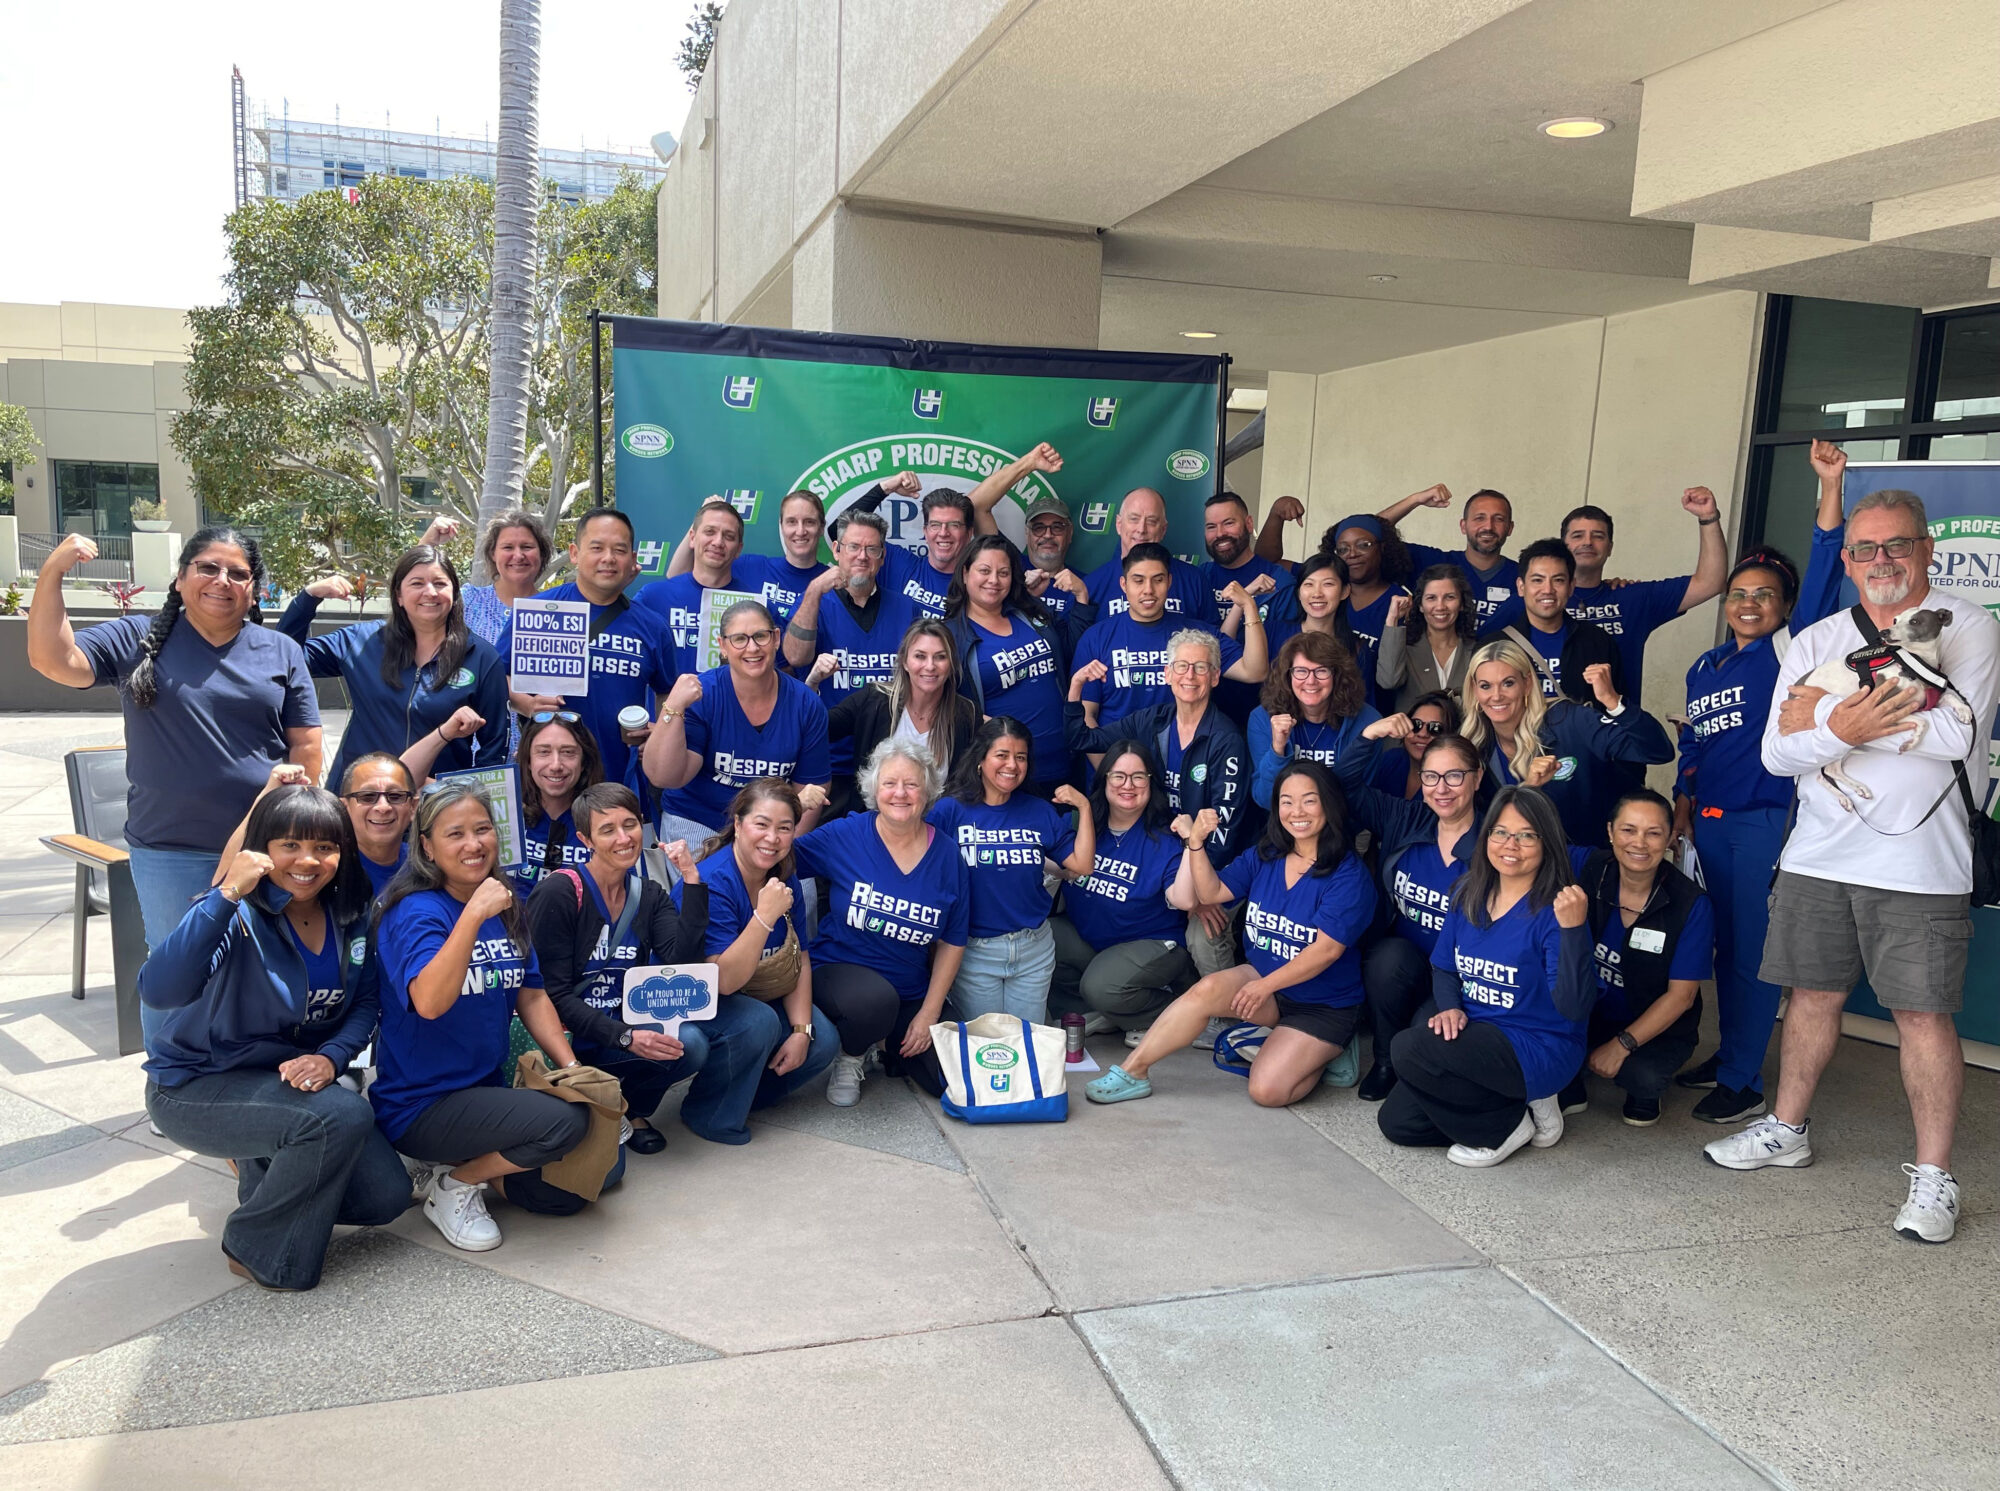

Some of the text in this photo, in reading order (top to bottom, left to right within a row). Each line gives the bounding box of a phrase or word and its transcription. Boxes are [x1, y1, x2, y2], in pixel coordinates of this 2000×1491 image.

[635, 434, 660, 443] SPNN
[1177, 459, 1197, 467] SPNN
[808, 444, 1042, 505] SHARP PROFESSINA
[1951, 519, 2000, 534] PROFE
[1929, 577, 1953, 586] ITED
[1957, 578, 1979, 587] FOR
[903, 579, 947, 609] RESPE
[518, 612, 583, 632] 100% ESI
[1566, 603, 1620, 619] ESPECT
[515, 636, 585, 655] DEFICIENCY
[590, 632, 643, 655] PECT
[516, 656, 582, 675] DETECTED
[591, 655, 641, 677] RSES
[833, 648, 898, 667] RESPEC
[991, 638, 1051, 672] RESPE
[1111, 648, 1169, 668] RESPE
[1000, 658, 1056, 689] NURSE
[1113, 667, 1167, 688] NURS
[1688, 685, 1744, 719] ESPECT
[1693, 711, 1743, 737] URSES
[714, 751, 797, 777] RESPECT
[957, 824, 1042, 844] RESPECT
[960, 845, 1042, 867] NURSES
[1094, 853, 1138, 881] SPECT
[1068, 875, 1129, 902] URSES
[1394, 869, 1450, 912] RESPE
[851, 880, 942, 926] RESPECT
[846, 905, 933, 946] NURSES
[1245, 900, 1318, 944] RESPECT
[1244, 924, 1301, 961] NURSE
[1455, 947, 1518, 985] ESPECT
[591, 985, 610, 997] OF
[640, 989, 654, 1000] I'M
[655, 989, 674, 999] PROUD
[676, 988, 683, 997] TO
[685, 988, 692, 997] BE
[647, 997, 690, 1008] UNION NURSE
